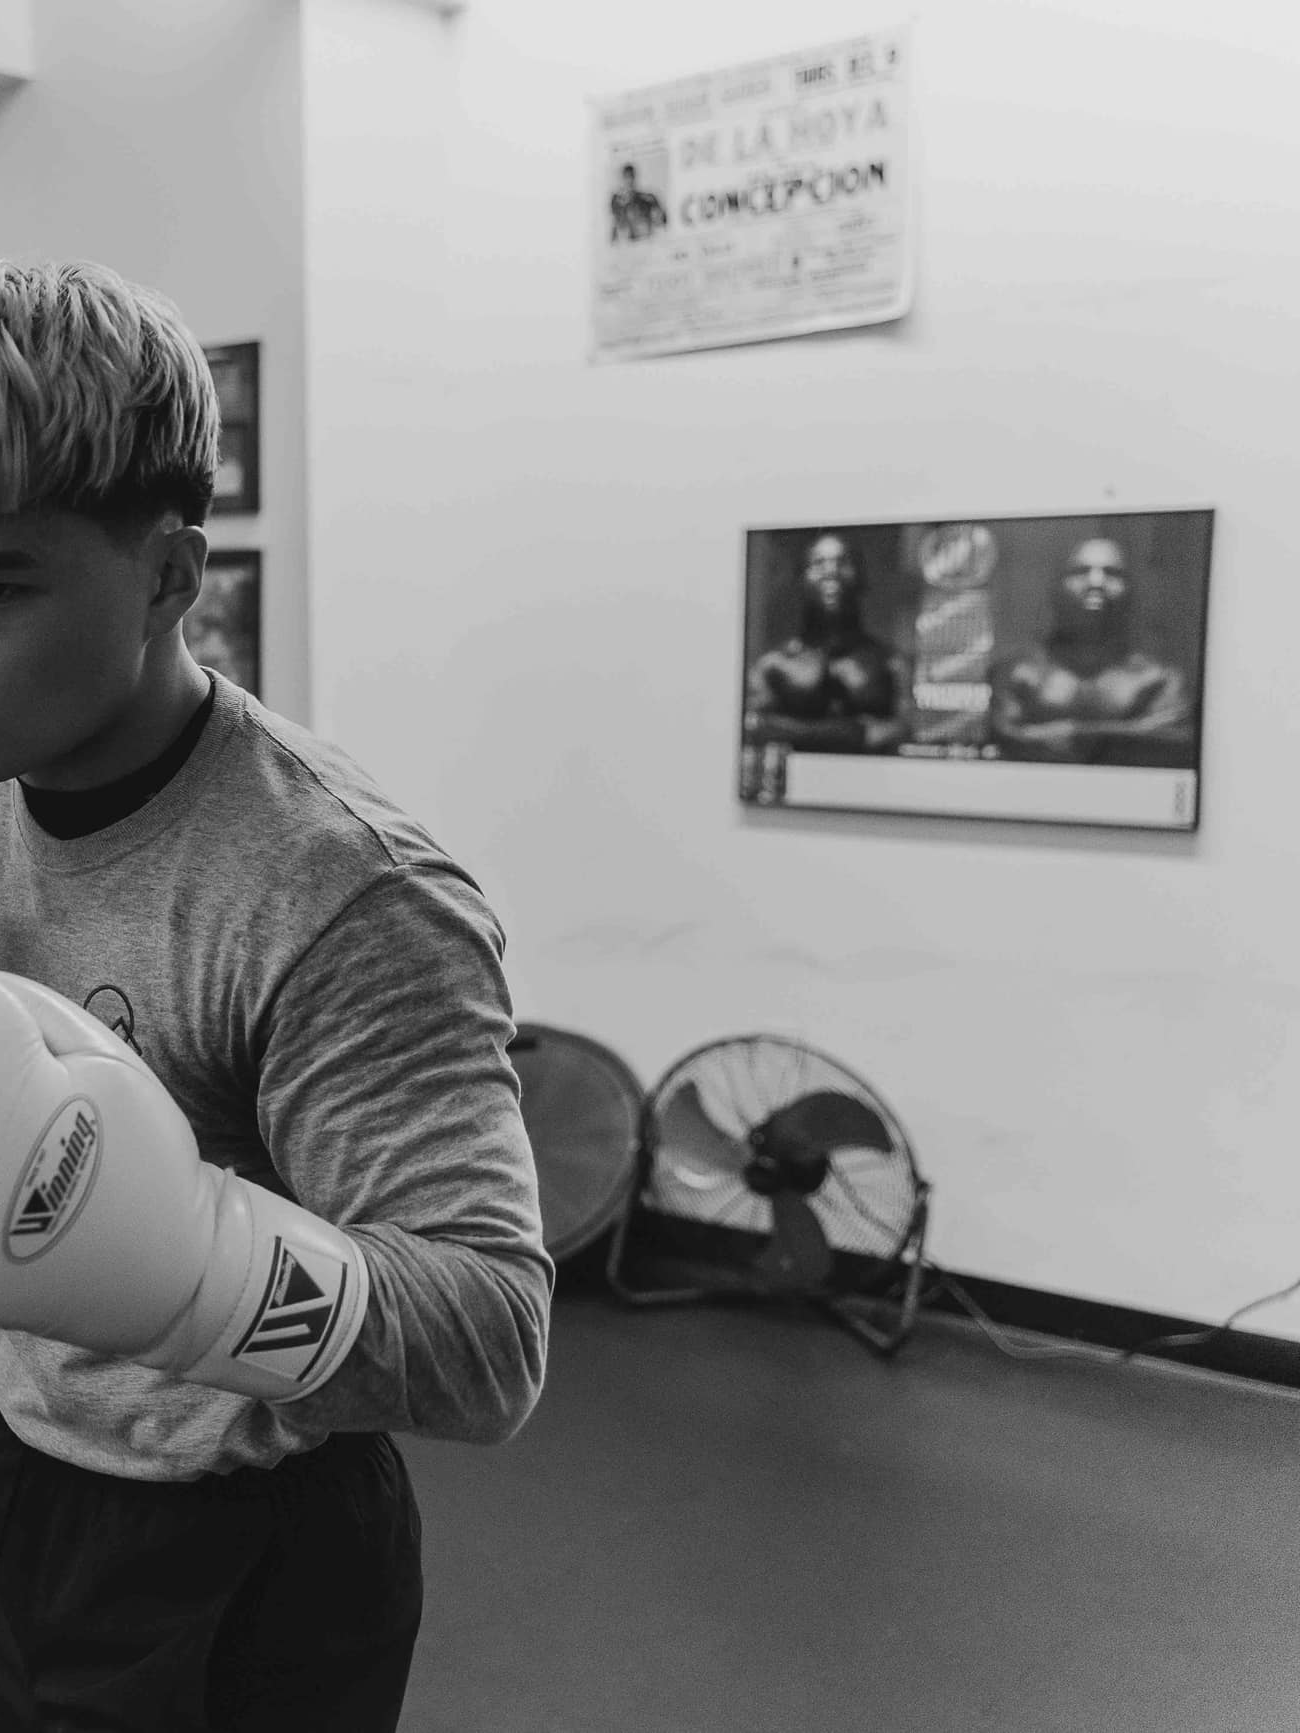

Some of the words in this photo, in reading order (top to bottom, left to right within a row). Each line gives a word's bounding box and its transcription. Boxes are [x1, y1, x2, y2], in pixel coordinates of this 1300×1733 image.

[733, 119, 780, 163] LA
[788, 98, 889, 152] HOYA
[680, 159, 886, 226] CONCEPCION
